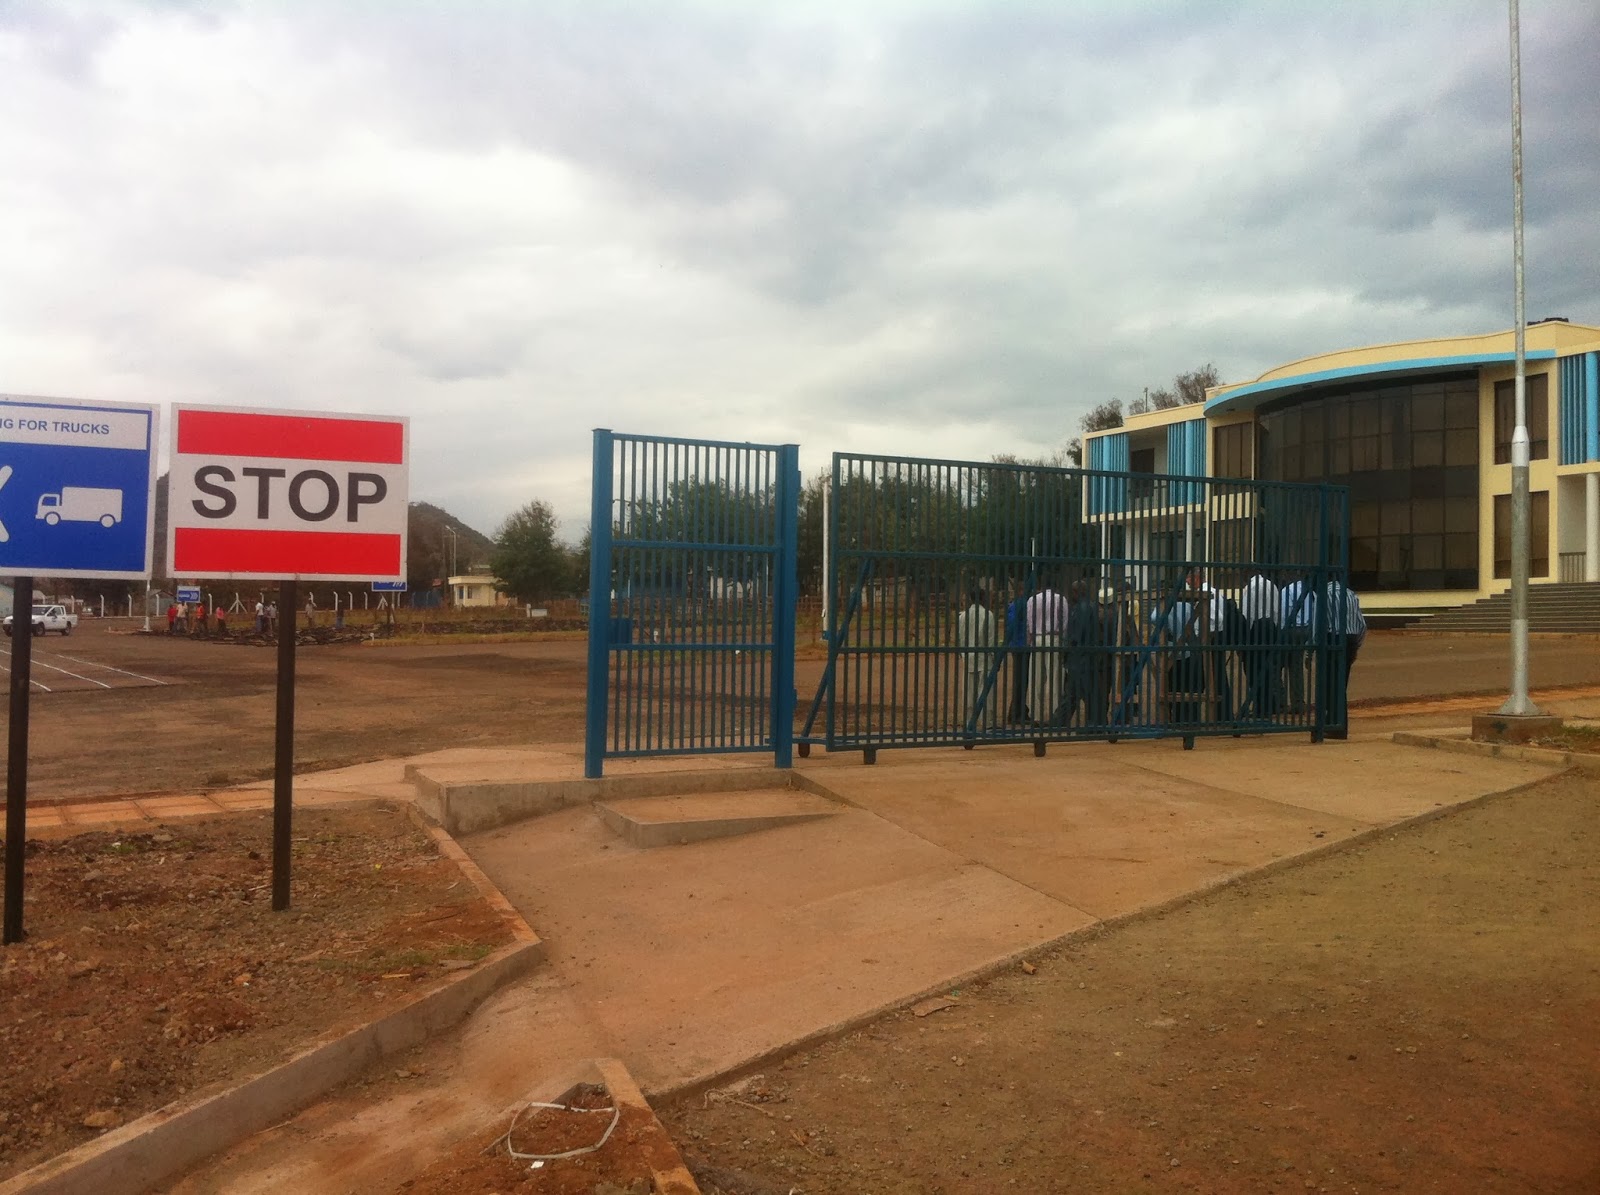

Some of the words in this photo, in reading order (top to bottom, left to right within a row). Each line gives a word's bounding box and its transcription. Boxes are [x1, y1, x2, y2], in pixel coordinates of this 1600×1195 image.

[0, 418, 14, 429] G
[18, 419, 48, 431] FOR
[52, 421, 110, 435] TRUCKS
[192, 465, 388, 522] STOP
